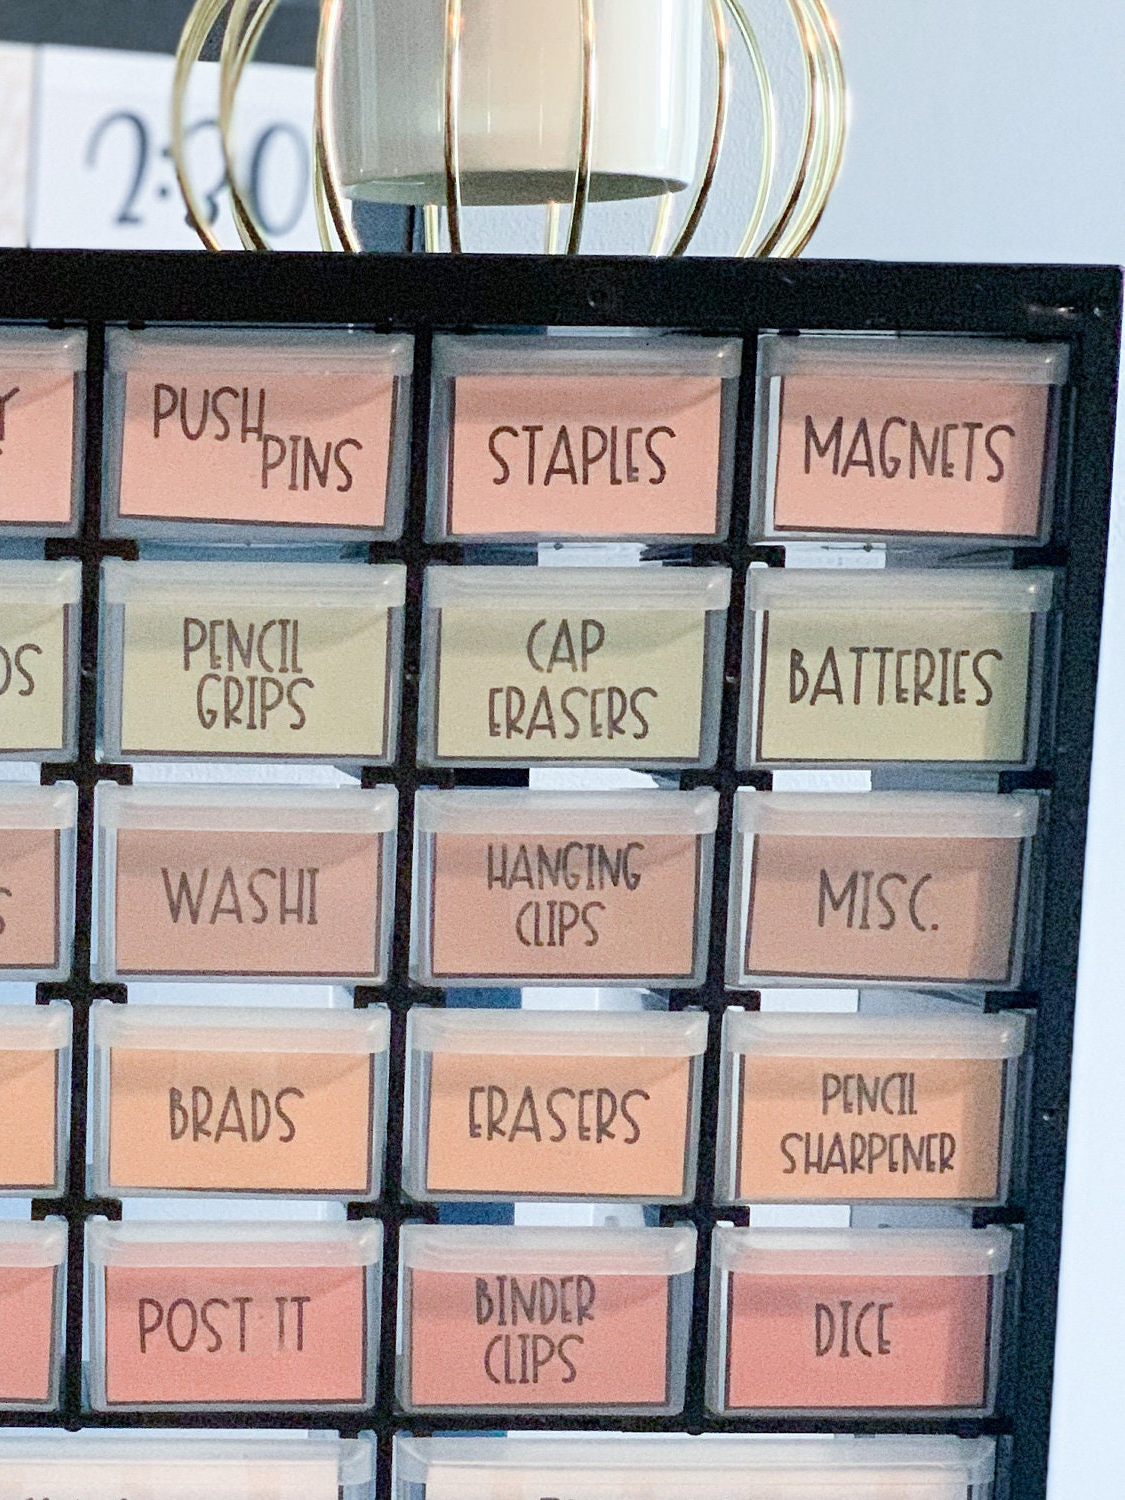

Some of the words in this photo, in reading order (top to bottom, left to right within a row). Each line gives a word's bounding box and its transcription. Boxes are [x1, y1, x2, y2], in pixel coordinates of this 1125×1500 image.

[152, 383, 266, 442] PUSH
[261, 434, 364, 493] PINS
[488, 425, 677, 486] STAPLES
[803, 414, 1016, 483] MAGNETS
[183, 617, 303, 675] PENCIL
[527, 618, 606, 675] CAP
[196, 674, 315, 731] GRIPS
[789, 646, 1003, 707] BATTERIES
[488, 685, 658, 740] ERASERS
[486, 842, 646, 891] HANGING
[161, 867, 320, 926] WASHI
[516, 901, 606, 948] CLIPS
[817, 868, 940, 933] MISC.
[169, 1086, 305, 1143] BRADS
[467, 1085, 650, 1144] ERASERS
[821, 1072, 918, 1116] PENCIL
[780, 1132, 956, 1174] SHARPENER
[138, 1296, 253, 1353] POST
[275, 1296, 311, 1352] IT
[475, 1274, 596, 1327] BINDER
[815, 1300, 894, 1357] DICE
[483, 1333, 585, 1384] CLIPS
